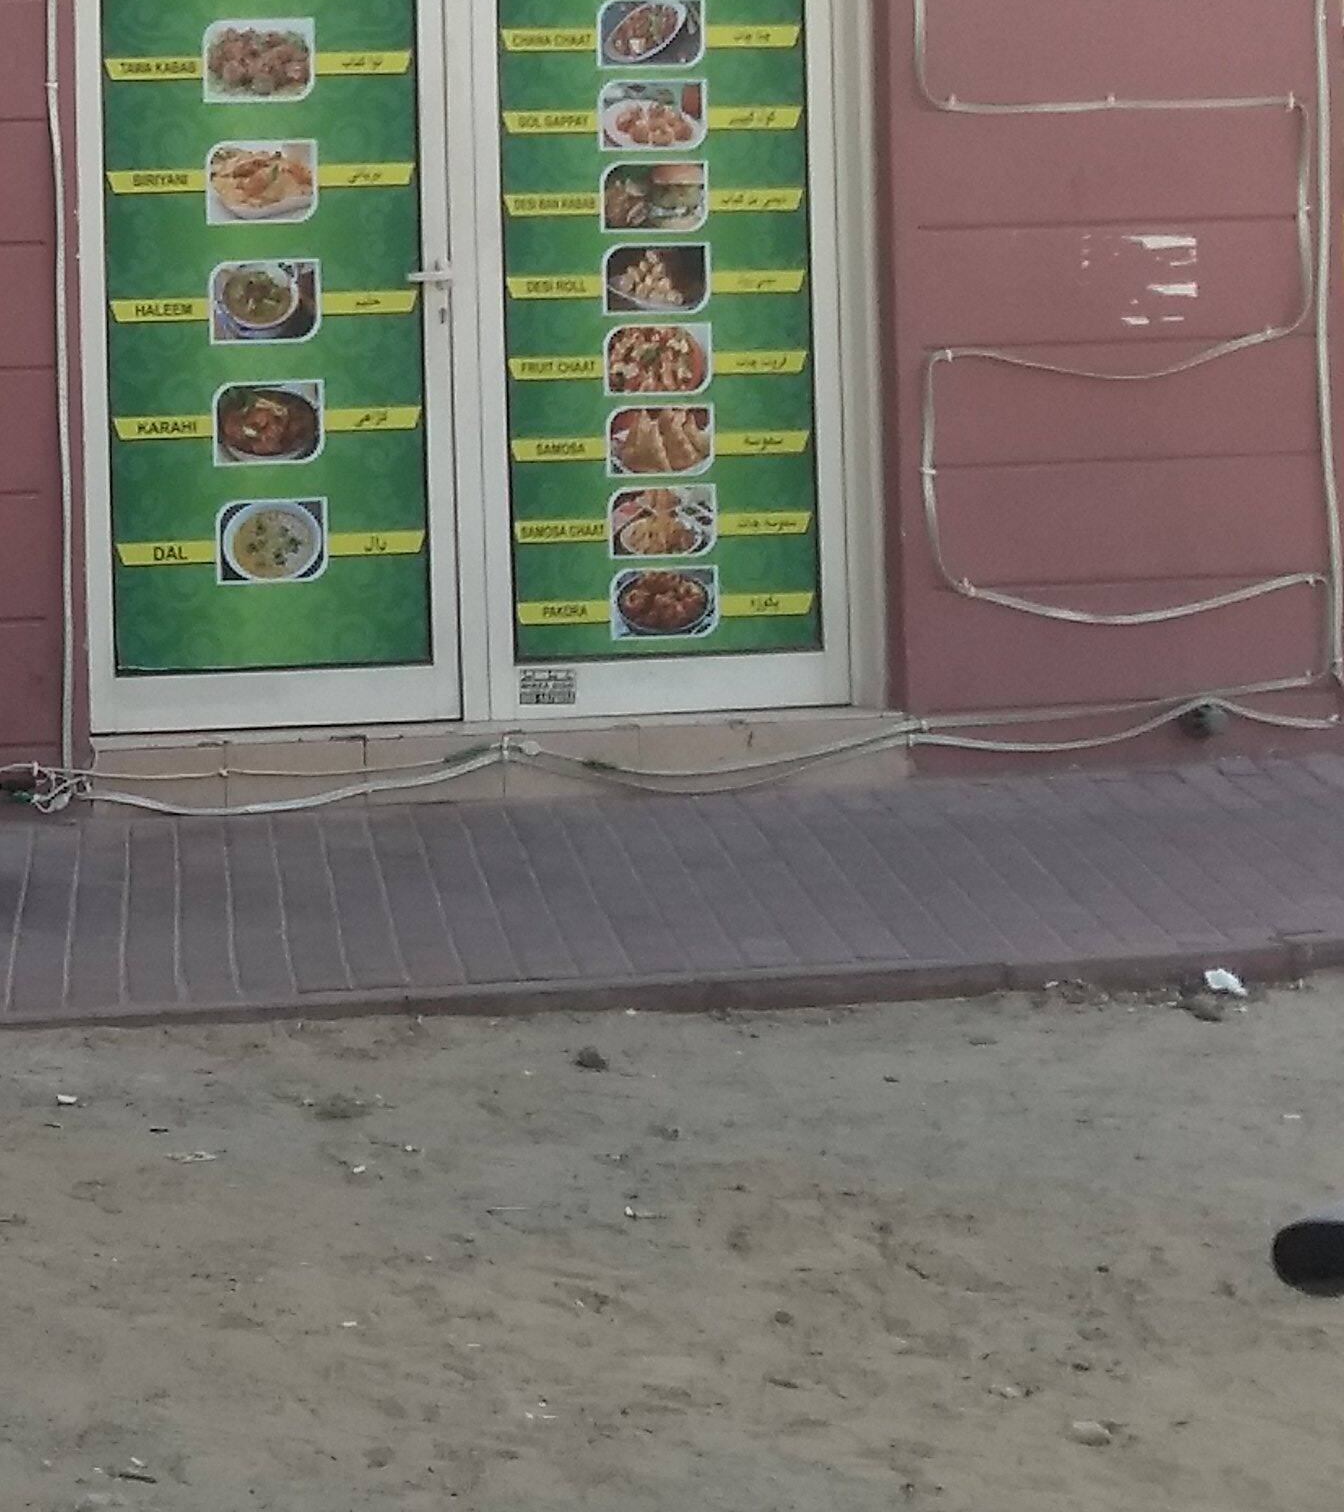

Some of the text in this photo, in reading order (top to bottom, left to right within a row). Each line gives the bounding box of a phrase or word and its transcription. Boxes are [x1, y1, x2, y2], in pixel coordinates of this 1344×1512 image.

[135, 303, 193, 317] HALEEM
[137, 421, 197, 434] KARAHI
[153, 545, 188, 561] DAL
